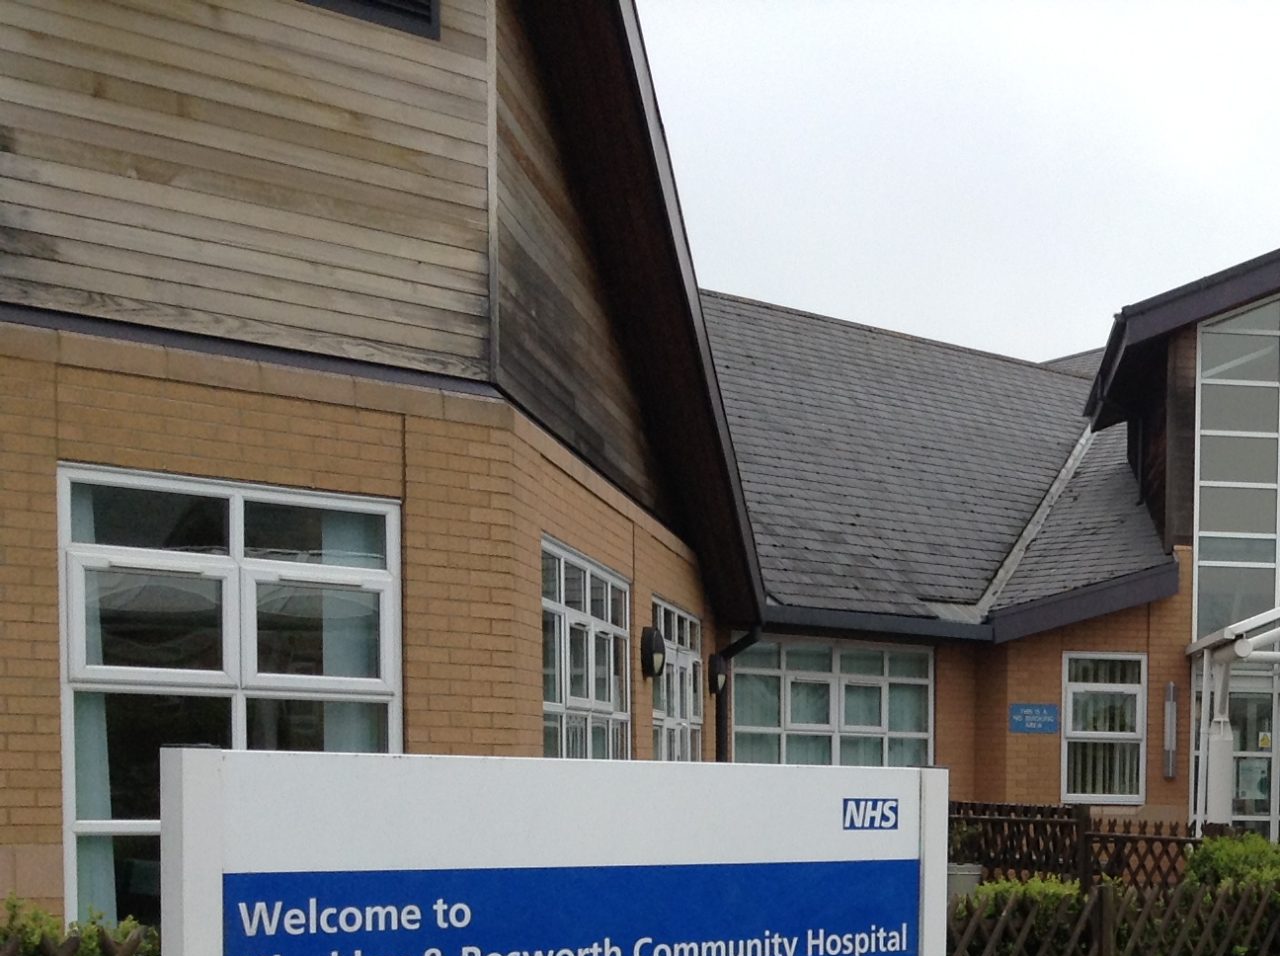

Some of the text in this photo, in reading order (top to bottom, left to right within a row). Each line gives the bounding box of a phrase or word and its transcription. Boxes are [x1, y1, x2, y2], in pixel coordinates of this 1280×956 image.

[844, 800, 897, 828] NHS
[238, 898, 471, 936] Welcome to
